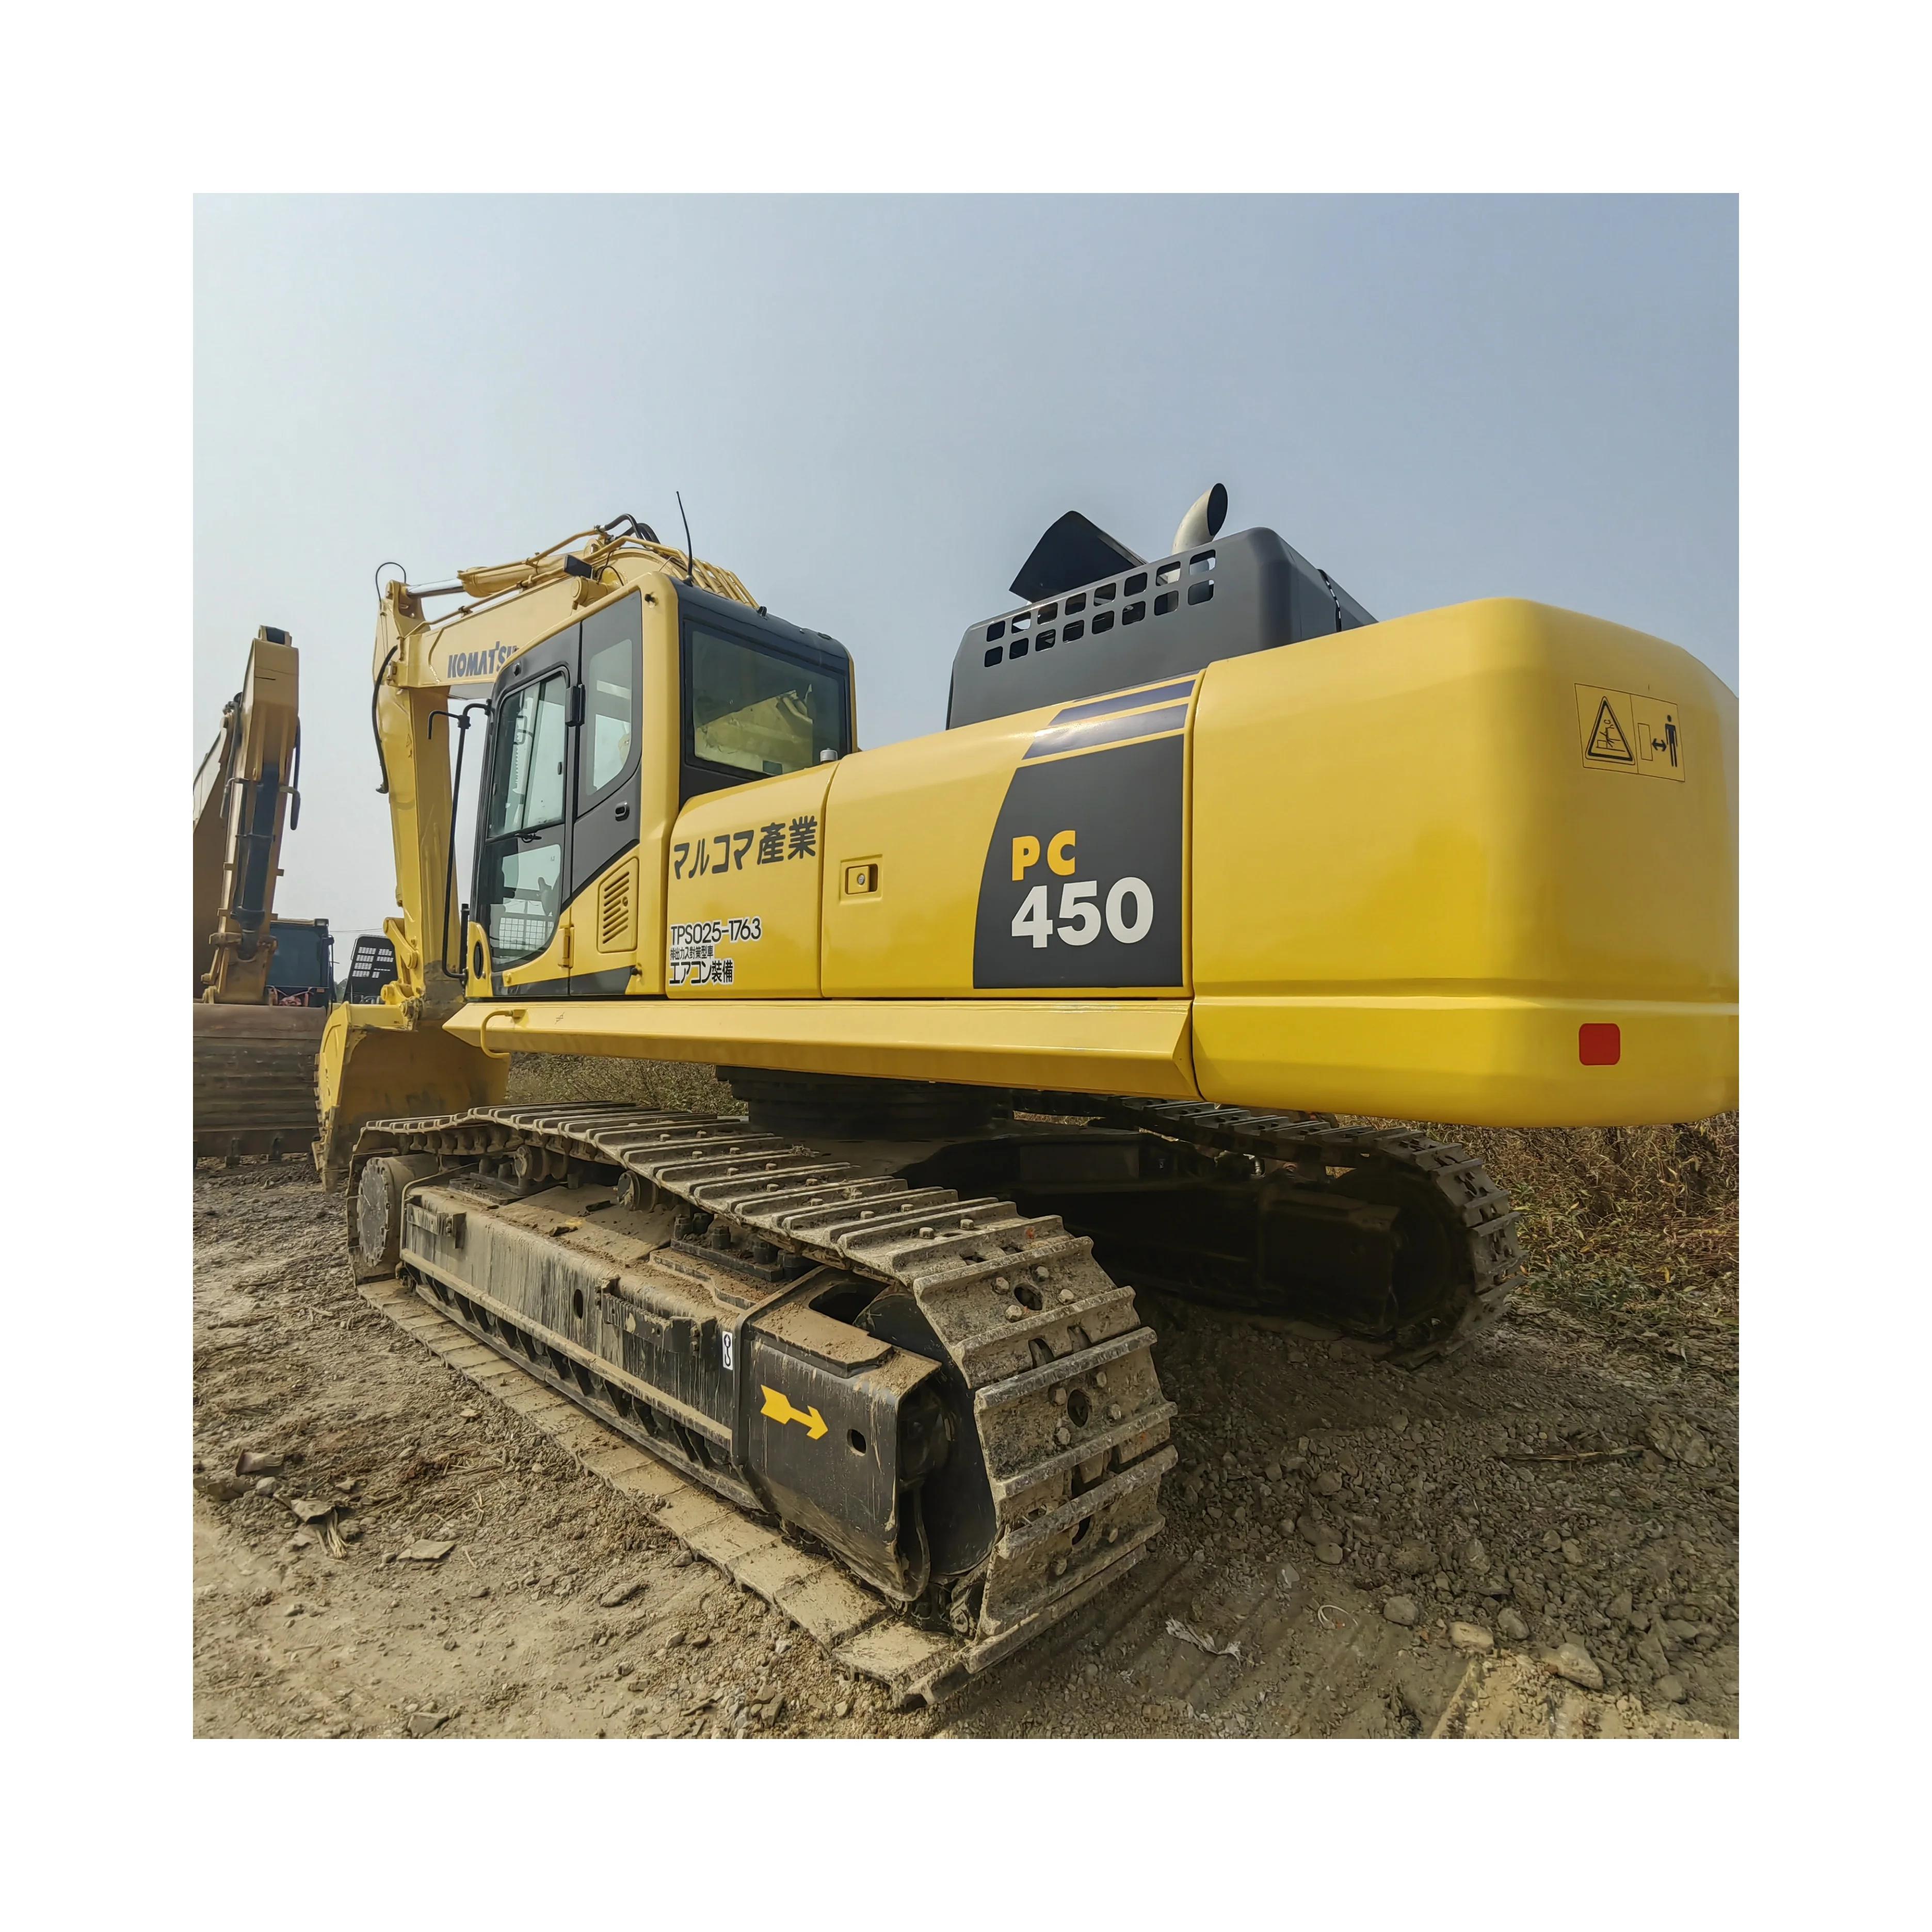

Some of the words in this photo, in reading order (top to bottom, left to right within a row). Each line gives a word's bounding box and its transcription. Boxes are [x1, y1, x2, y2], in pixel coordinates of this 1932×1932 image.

[1012, 830, 1075, 881] PC
[670, 918, 761, 945] TPS025-1763
[1011, 877, 1154, 948] 450
